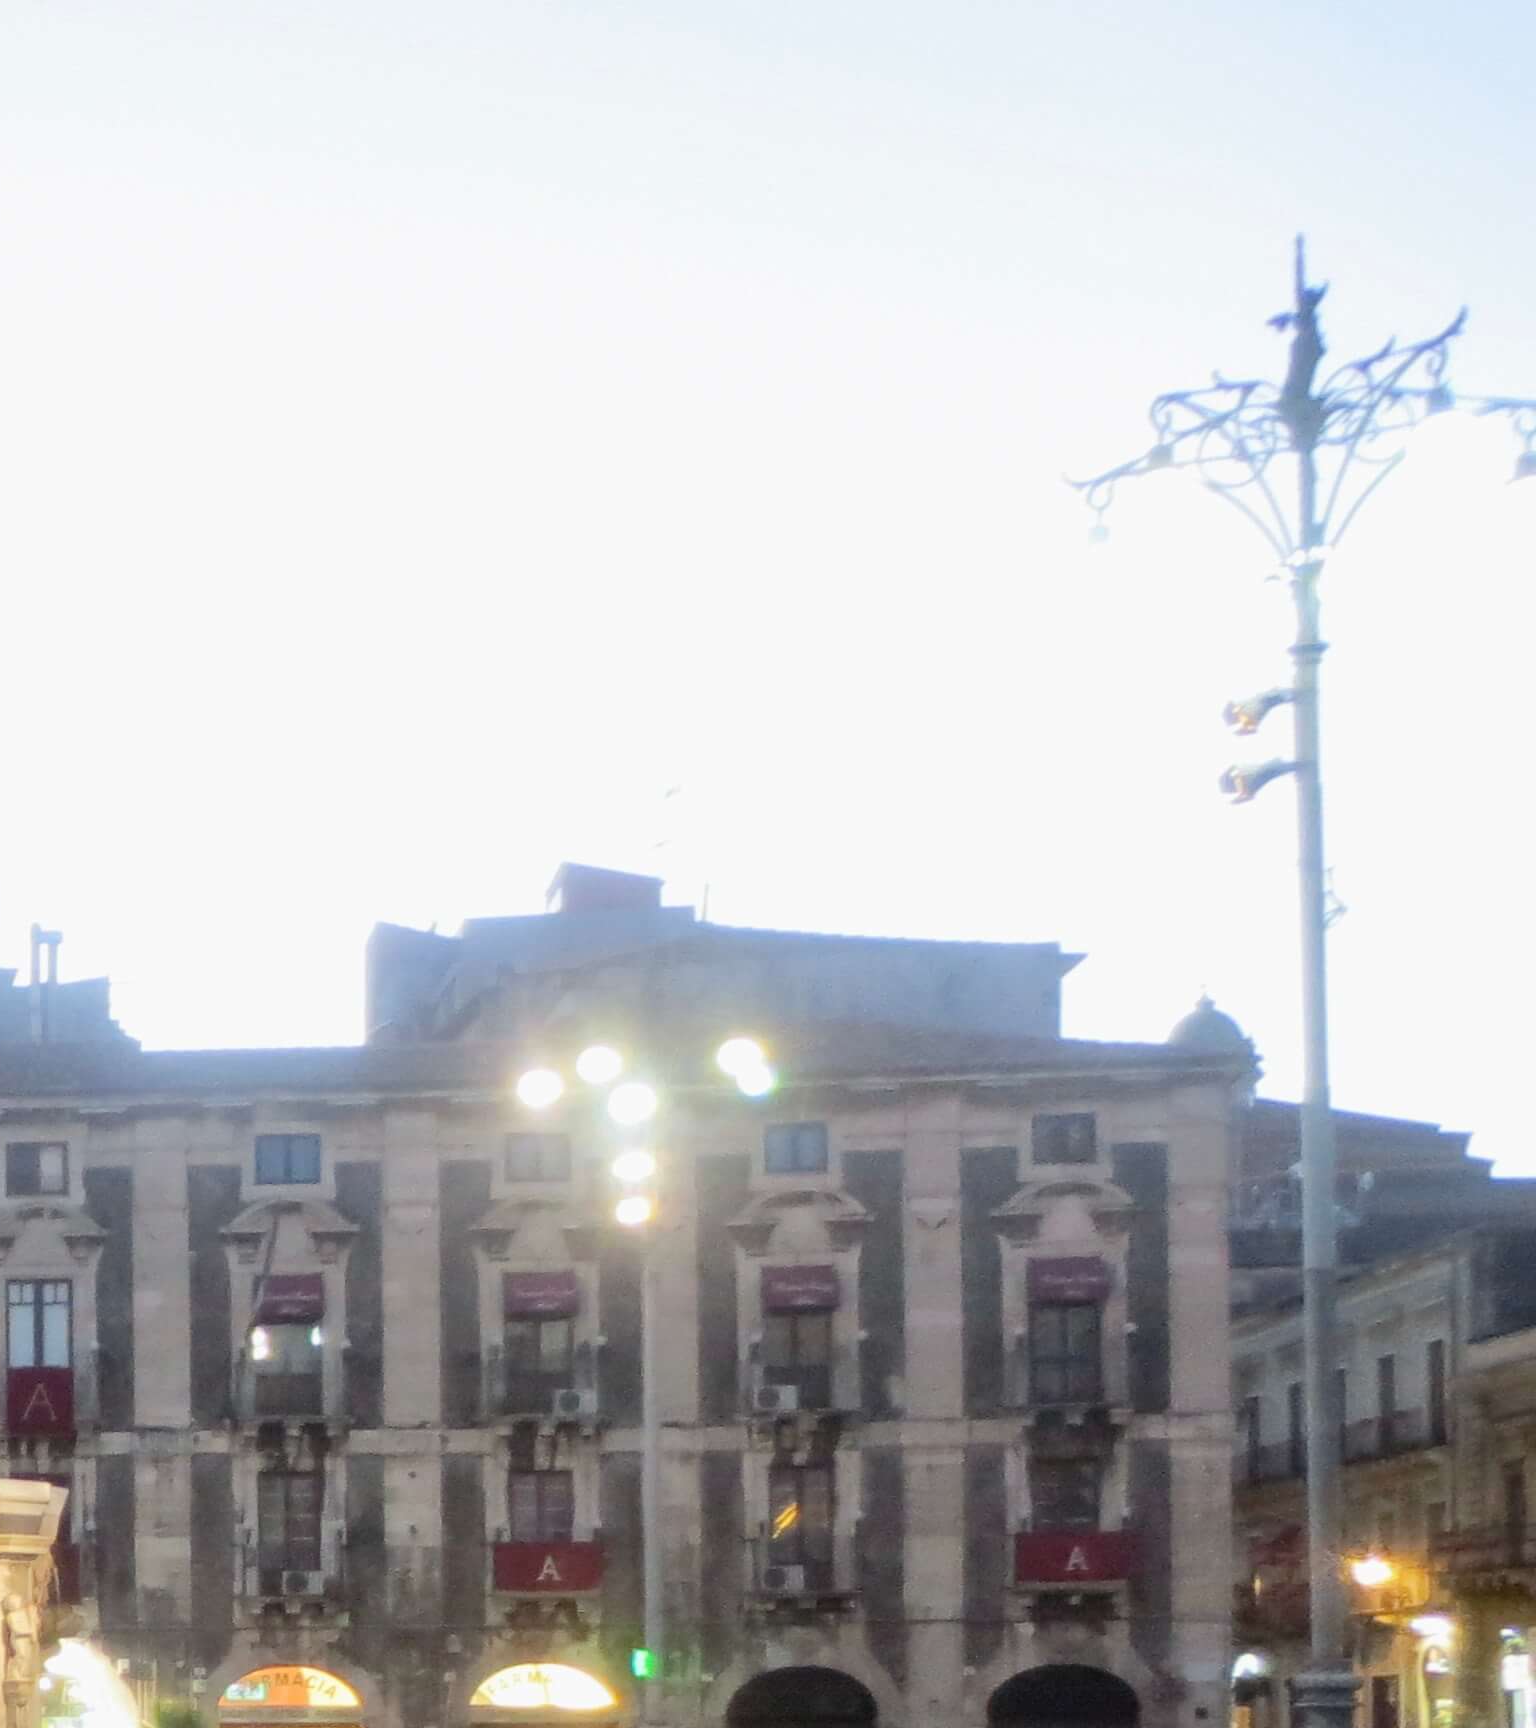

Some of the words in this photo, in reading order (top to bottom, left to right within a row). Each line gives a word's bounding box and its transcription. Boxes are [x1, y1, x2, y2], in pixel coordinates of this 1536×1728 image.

[21, 1382, 58, 1421] A
[536, 1555, 562, 1581] A
[1065, 1546, 1089, 1571] A
